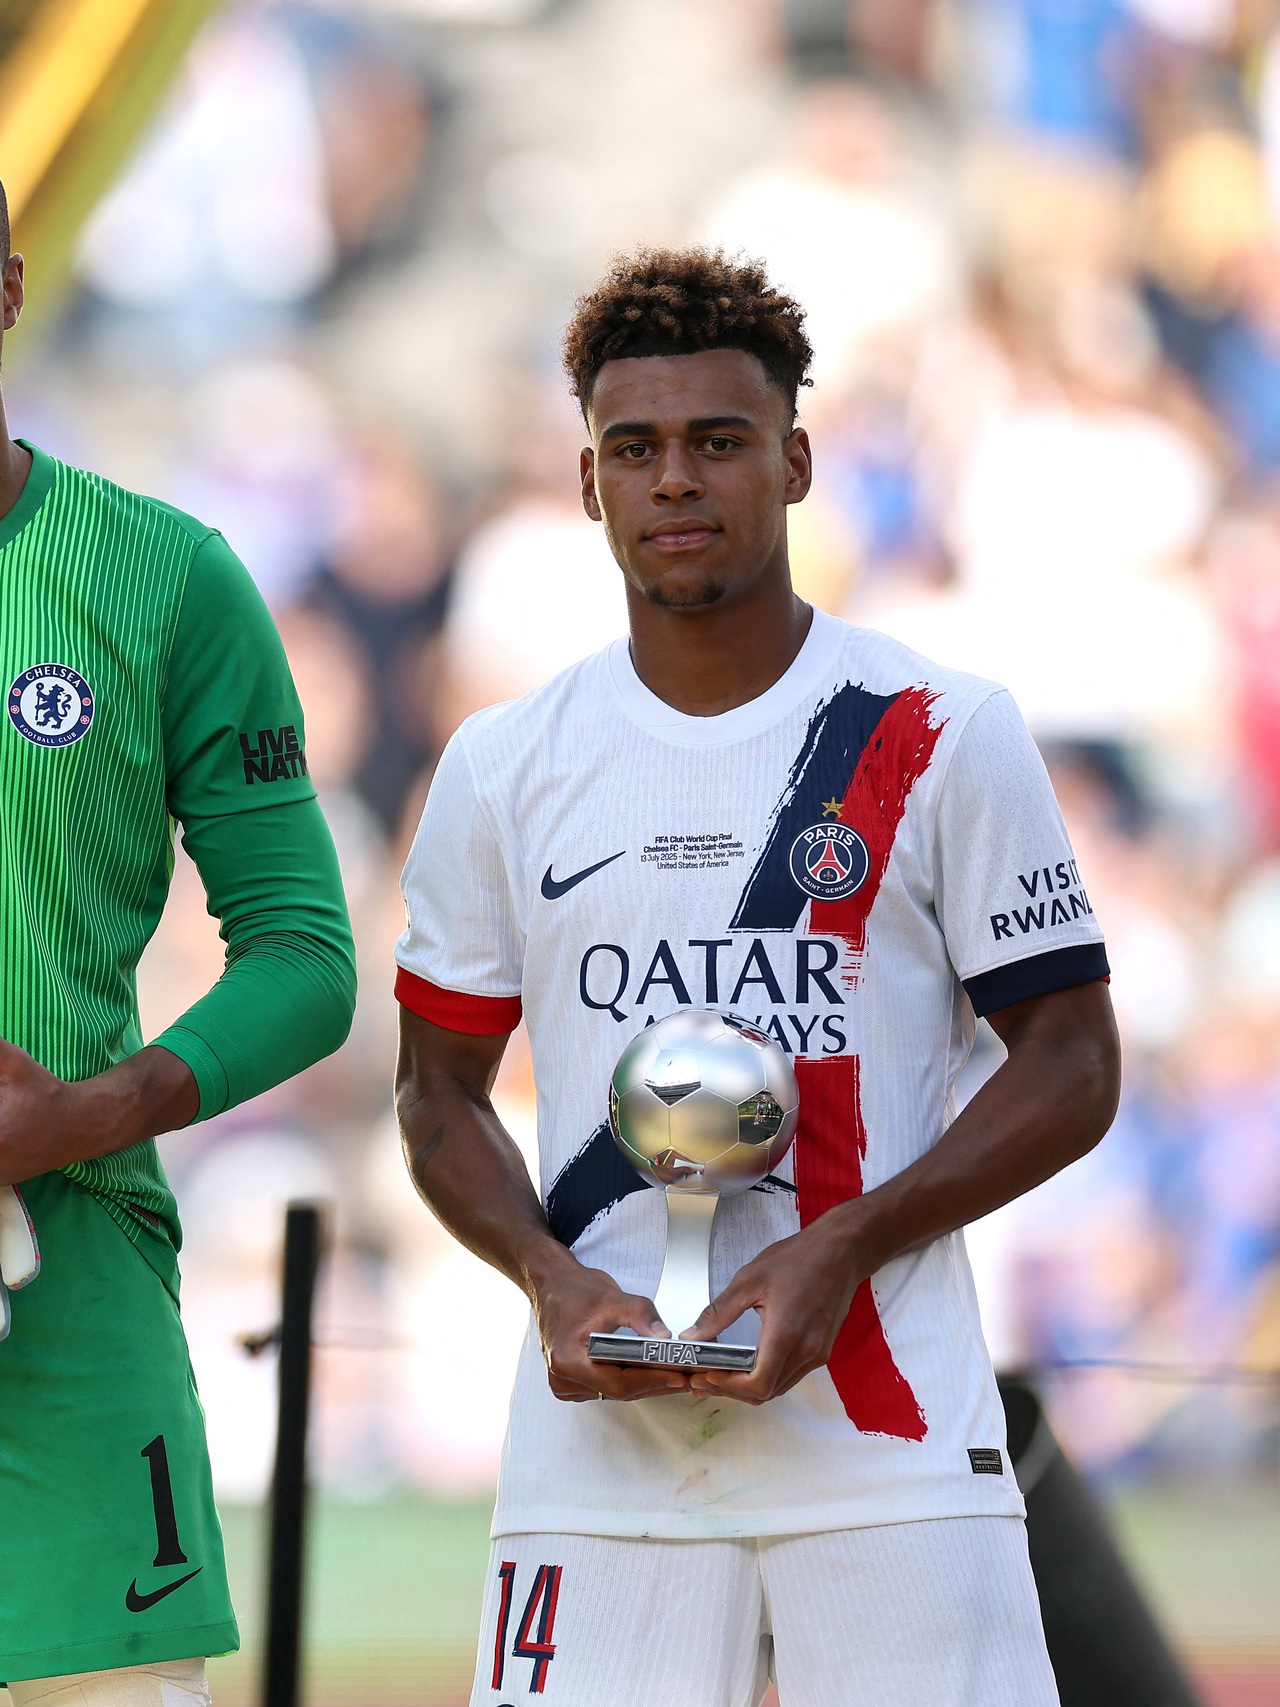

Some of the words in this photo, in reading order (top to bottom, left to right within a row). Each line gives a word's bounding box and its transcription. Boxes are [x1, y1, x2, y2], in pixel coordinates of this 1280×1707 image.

[25, 666, 82, 688] CHELSEA
[19, 724, 55, 744] FOOTBALL
[58, 731, 77, 743] CLUB
[239, 725, 299, 759] LIVE
[655, 836, 669, 844] FIFA
[706, 834, 719, 842] Cup
[719, 832, 733, 841] Final
[803, 826, 856, 846] PARIS
[644, 845, 669, 853] Chelsea
[683, 844, 700, 852] Paris
[701, 841, 743, 851] Saint-Germain
[648, 854, 660, 862] July
[661, 853, 678, 861] 2025
[698, 852, 713, 860] York,
[714, 851, 726, 859] New
[726, 850, 745, 859] Jersey
[678, 861, 698, 869] States
[706, 860, 729, 868] America
[802, 876, 821, 891] SAINT
[825, 879, 854, 894] GERMAIN
[580, 938, 845, 1023] QATAR
[141, 1434, 188, 1567] 1
[491, 1560, 563, 1696] 14
